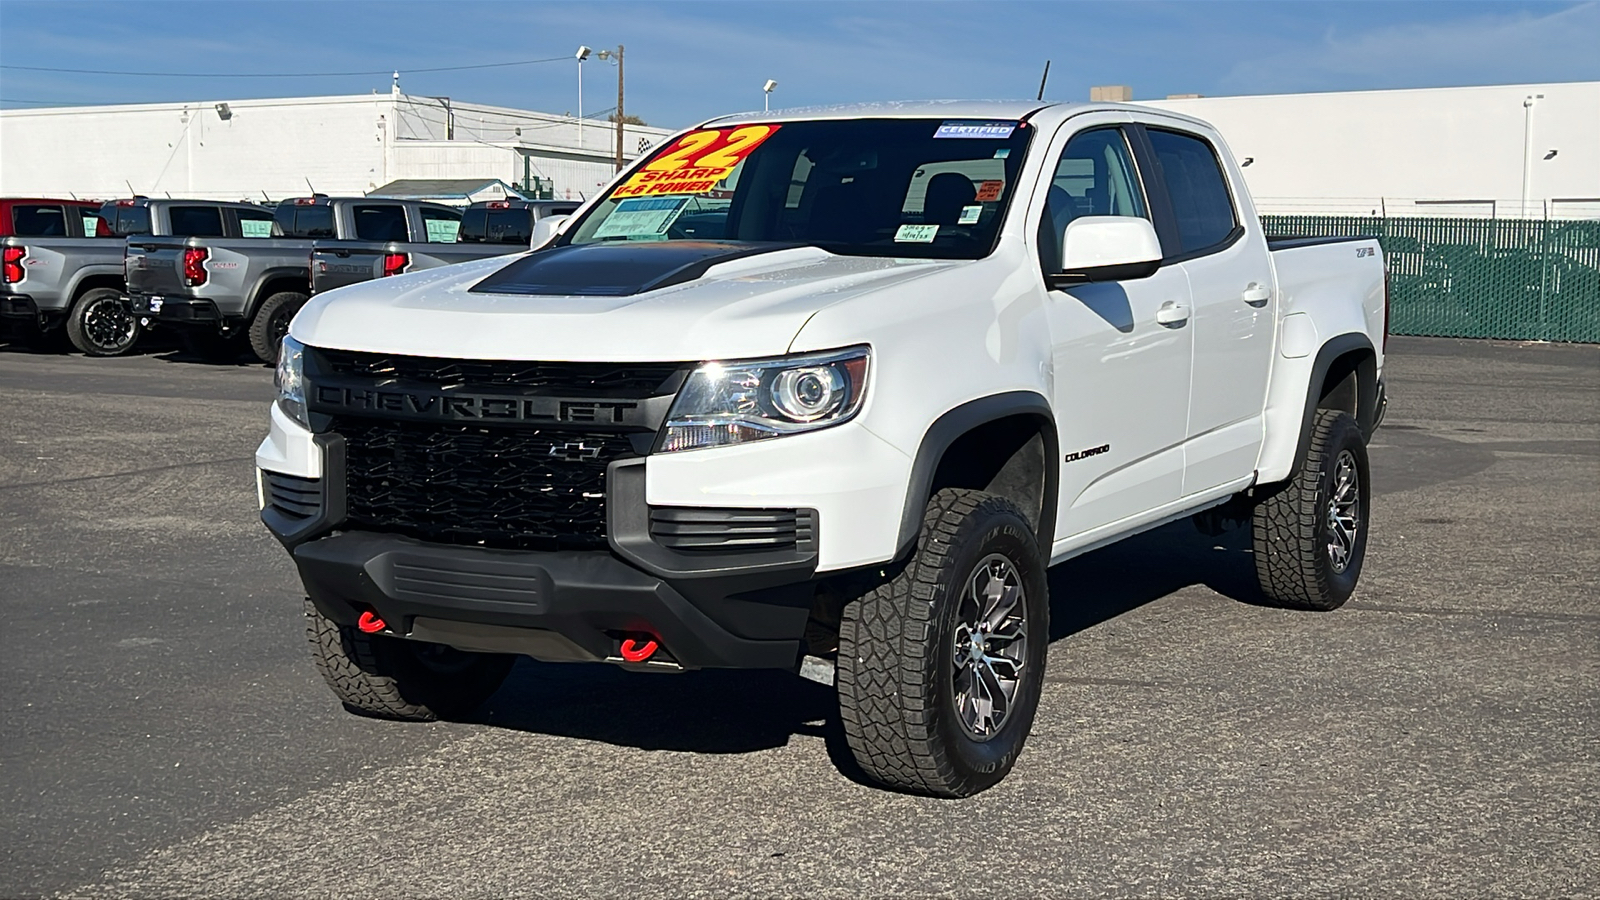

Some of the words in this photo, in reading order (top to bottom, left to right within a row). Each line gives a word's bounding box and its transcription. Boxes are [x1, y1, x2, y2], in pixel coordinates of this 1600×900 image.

[940, 126, 1010, 134] CERTIFIED
[645, 125, 771, 172] 22
[639, 167, 728, 183] SHARP
[613, 182, 645, 197] V-6
[647, 180, 716, 195] POWER
[316, 385, 638, 424] CHEVROLET
[1065, 444, 1110, 463] COLORADO
